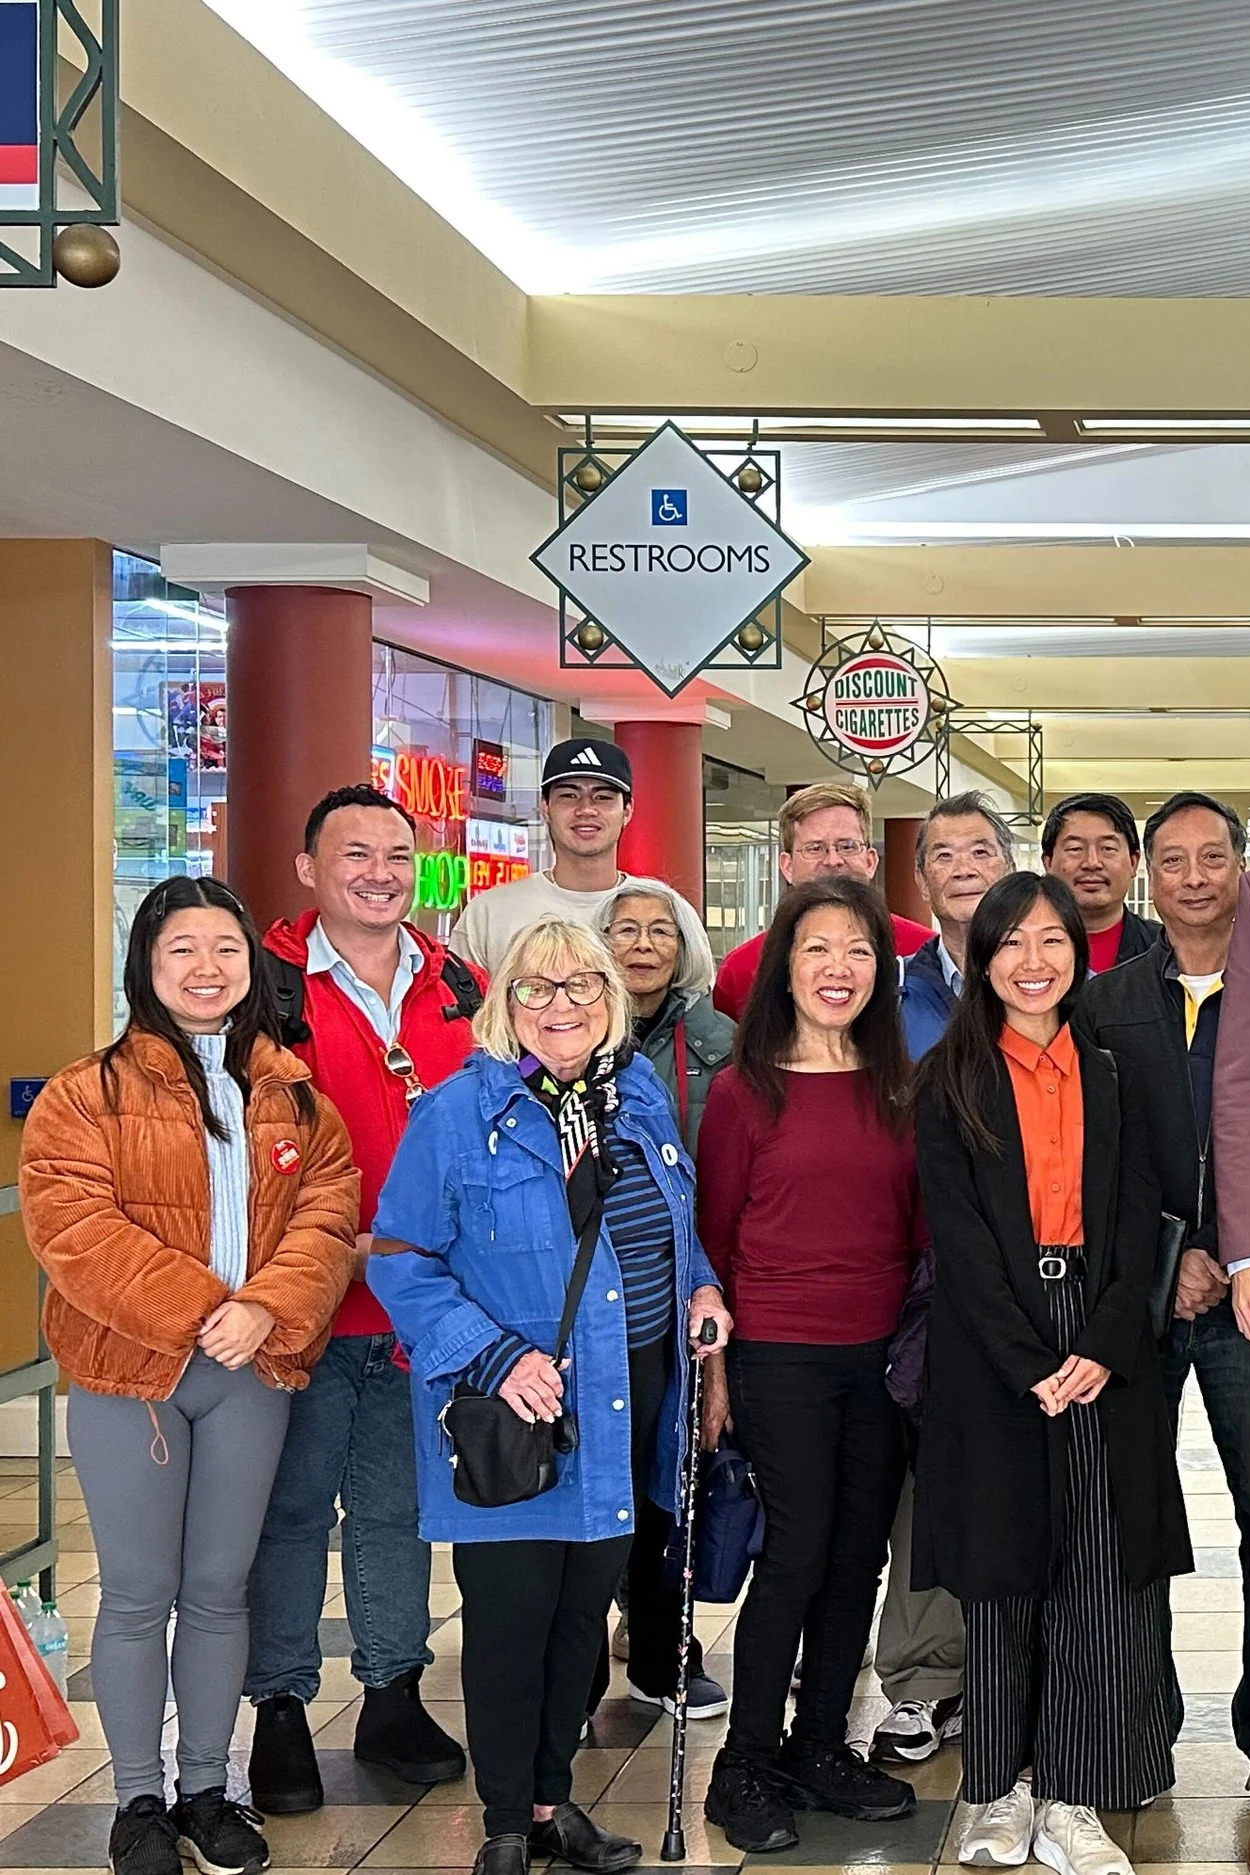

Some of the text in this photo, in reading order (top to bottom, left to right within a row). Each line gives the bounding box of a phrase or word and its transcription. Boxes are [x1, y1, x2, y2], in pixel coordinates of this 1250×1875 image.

[568, 543, 770, 573] RESTROOMS
[835, 670, 918, 698] DISCOUNT
[836, 708, 919, 738] CIGARETTES
[396, 753, 467, 820] SMOKE
[413, 852, 467, 909] HOP
